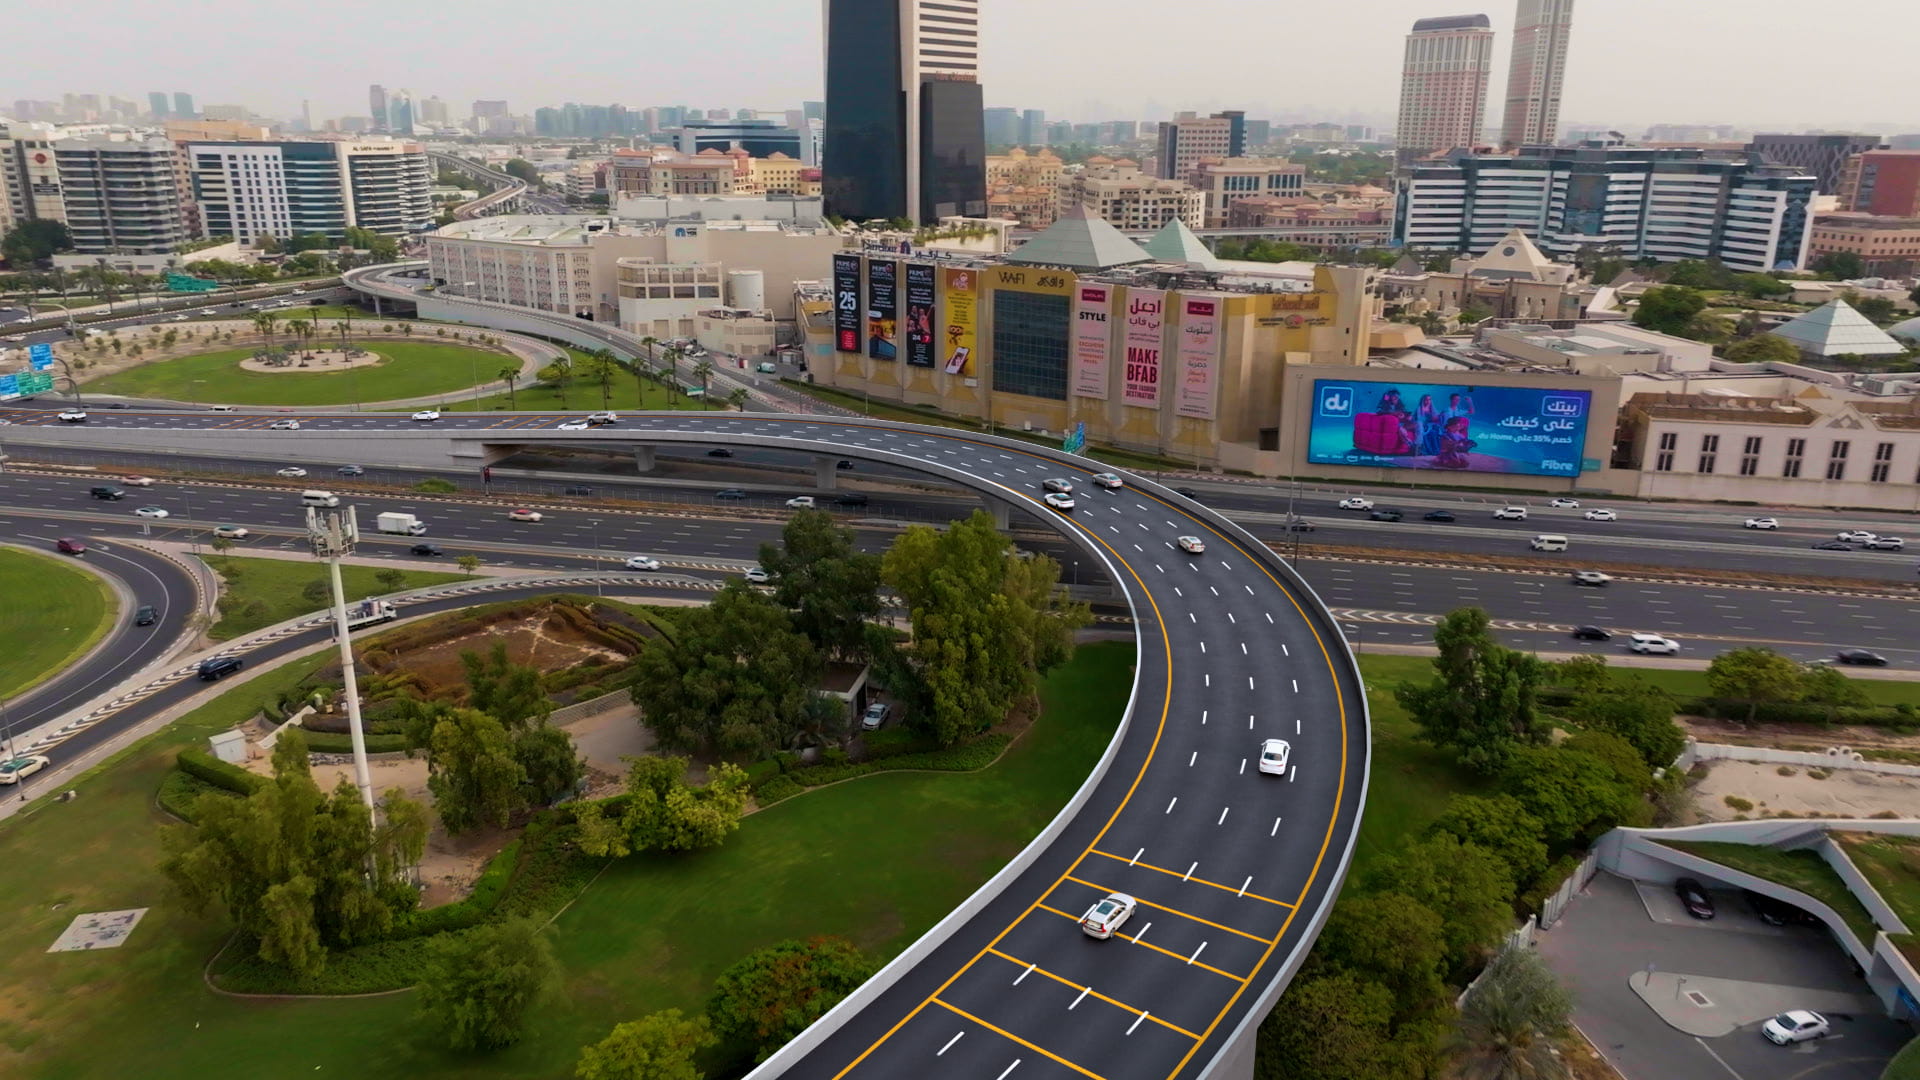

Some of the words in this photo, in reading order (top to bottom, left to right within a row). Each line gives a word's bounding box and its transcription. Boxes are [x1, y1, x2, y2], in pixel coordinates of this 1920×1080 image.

[999, 272, 1025, 285] WAFI
[839, 291, 857, 310] 25
[1130, 298, 1161, 316] اجعل
[1079, 311, 1106, 321] STYLE
[1128, 347, 1158, 365] MAKE
[1127, 364, 1157, 384] BFAB
[1325, 393, 1349, 411] du
[1547, 401, 1577, 416] بيتك
[1543, 418, 1575, 432] على
[1541, 460, 1574, 471] Fibre
